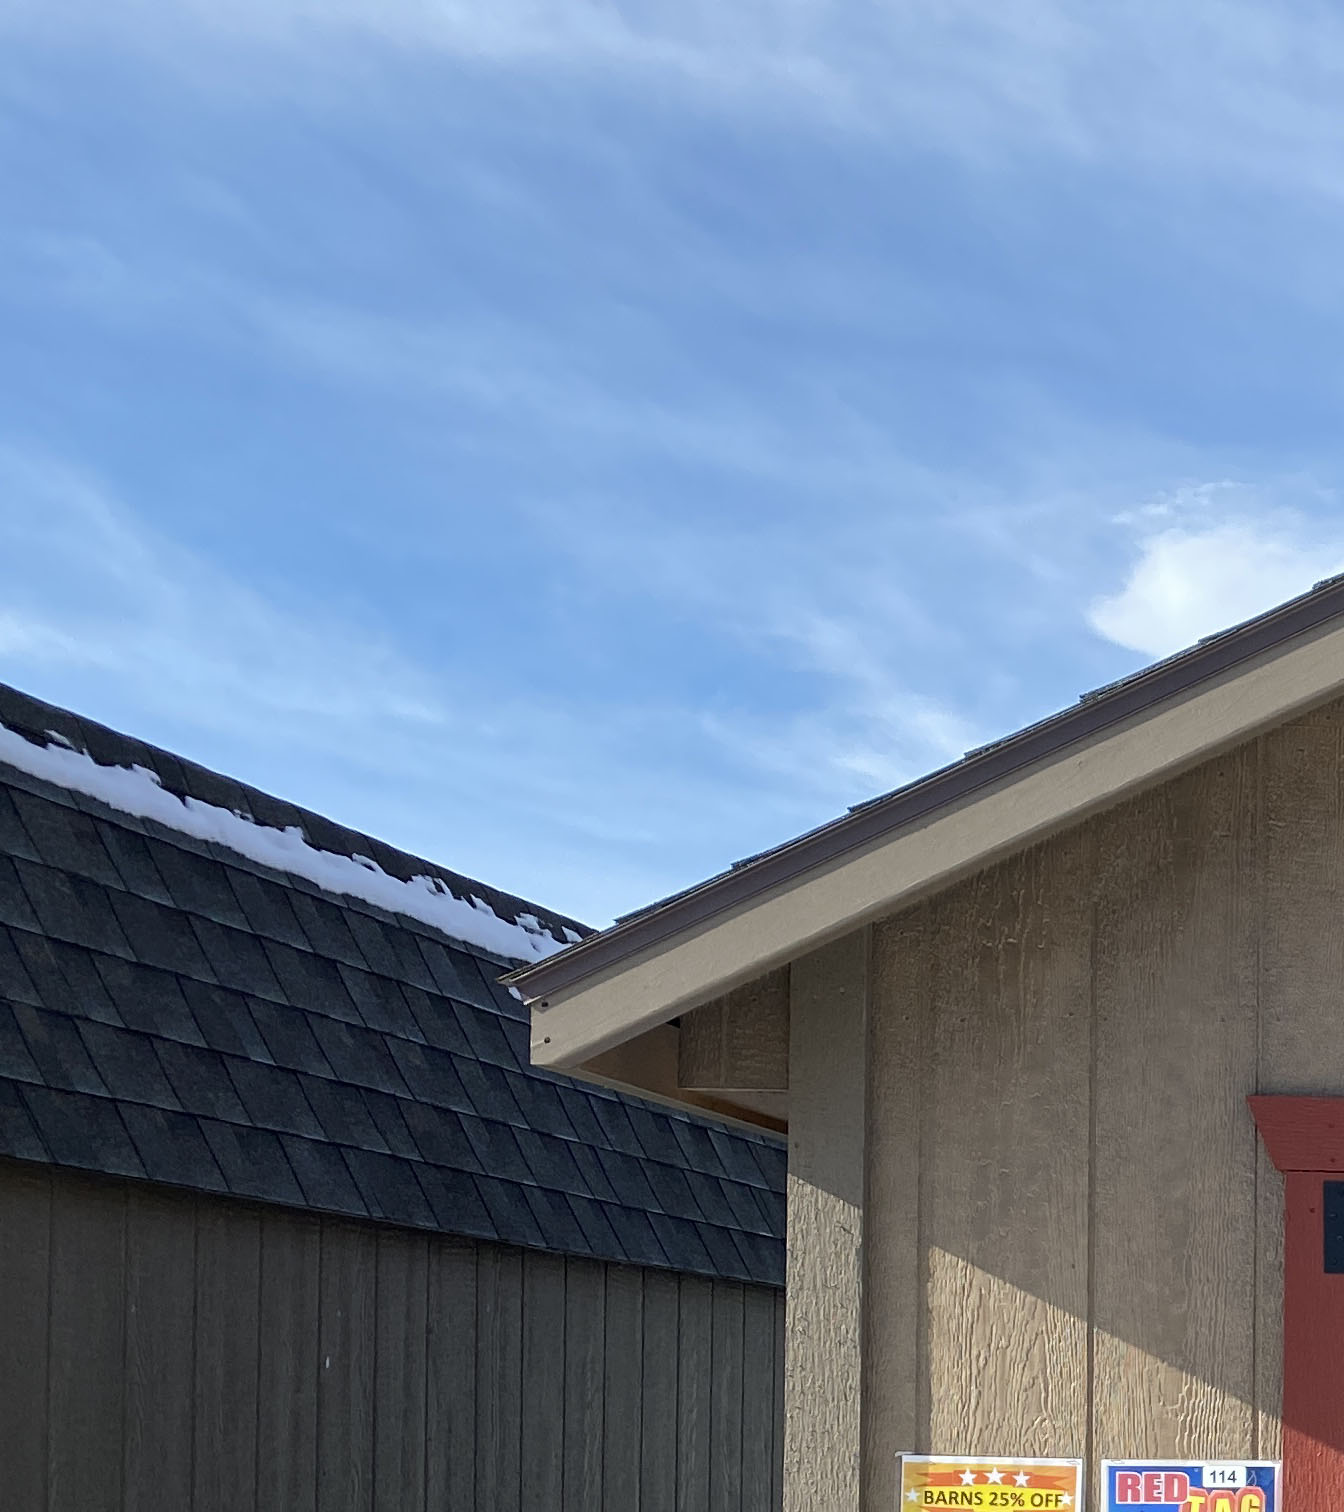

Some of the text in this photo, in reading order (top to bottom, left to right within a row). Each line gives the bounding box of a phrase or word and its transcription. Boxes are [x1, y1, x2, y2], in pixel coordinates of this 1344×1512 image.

[1210, 1470, 1237, 1483] 114
[1117, 1472, 1189, 1503] RED
[924, 1490, 1063, 1508] BARNS 25% OFF
